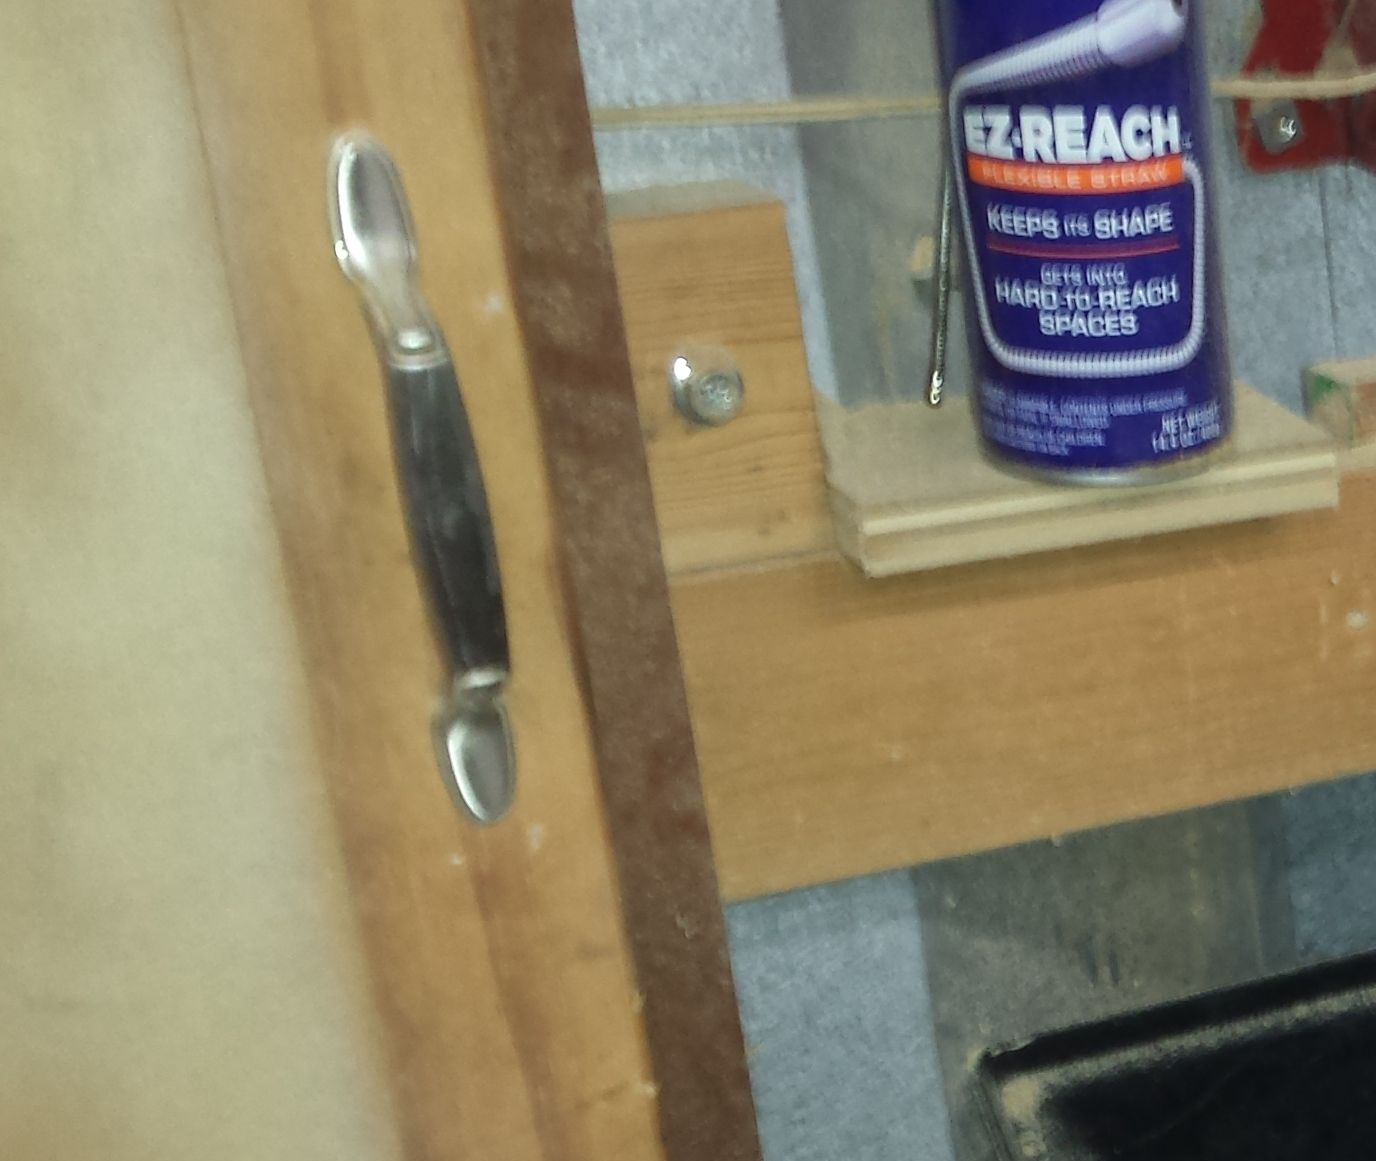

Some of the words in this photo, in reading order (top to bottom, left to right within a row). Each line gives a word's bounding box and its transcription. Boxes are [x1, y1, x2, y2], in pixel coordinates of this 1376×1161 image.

[982, 164, 1082, 190] FLEXIBLE
[1090, 160, 1169, 189] STRAW
[987, 202, 1060, 239] KEEPS
[1063, 213, 1091, 237] ITS
[1094, 202, 1174, 239] SHAPE
[1041, 263, 1083, 286] GETS
[1086, 263, 1128, 286] INTO
[995, 275, 1179, 311] HARD-TO-REACH
[1039, 307, 1140, 337] SPACES
